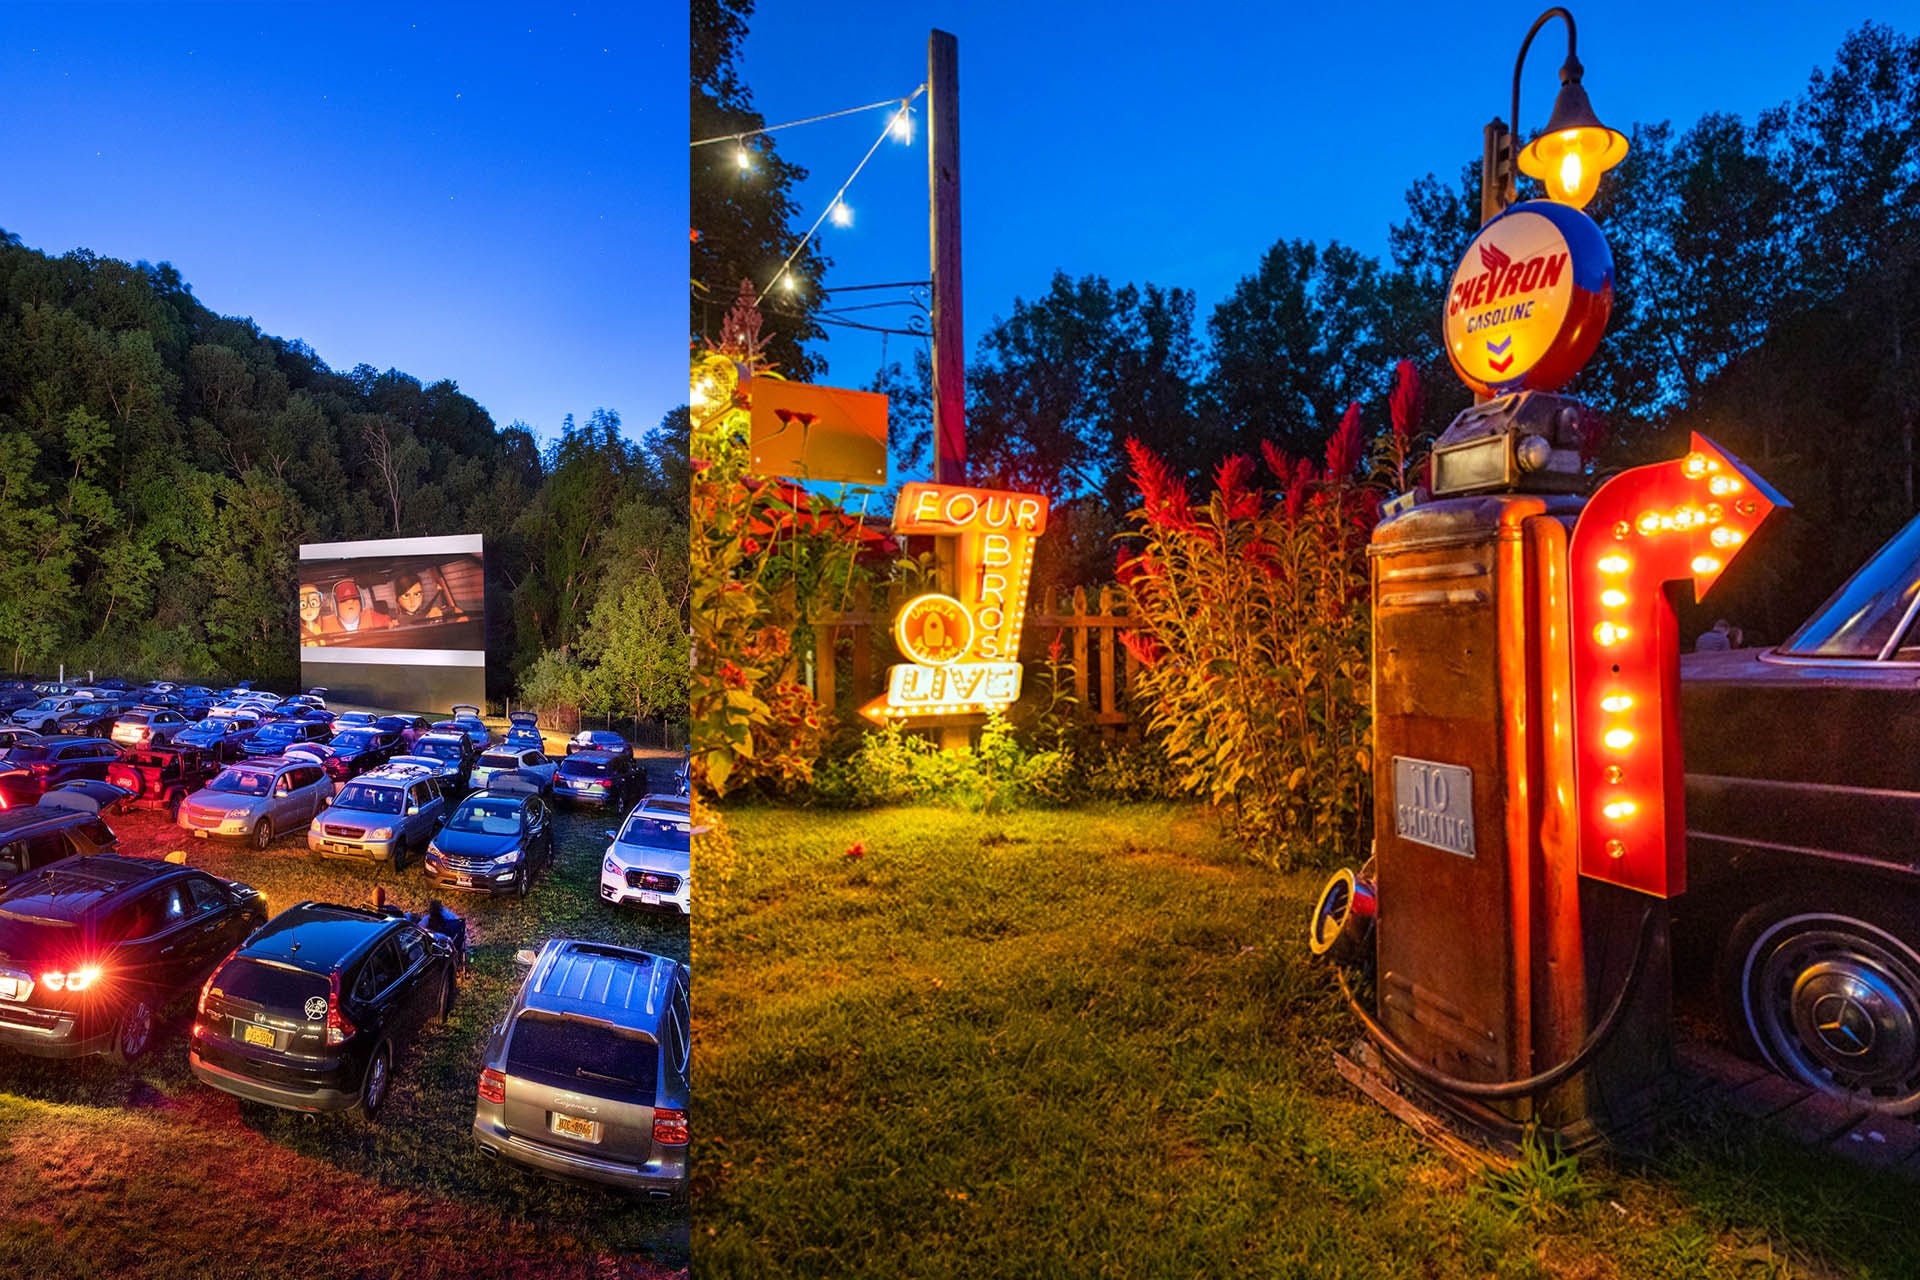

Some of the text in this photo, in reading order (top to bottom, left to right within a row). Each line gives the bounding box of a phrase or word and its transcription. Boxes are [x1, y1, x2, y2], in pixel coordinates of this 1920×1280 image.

[1450, 243, 1568, 317] CHEVRON
[1467, 301, 1535, 333] GASOLINE
[914, 491, 1040, 527] FOUR
[979, 534, 1011, 658] BROS
[900, 667, 1013, 701] LIVE
[1409, 765, 1450, 813] NO
[1399, 804, 1470, 850] SMOKING
